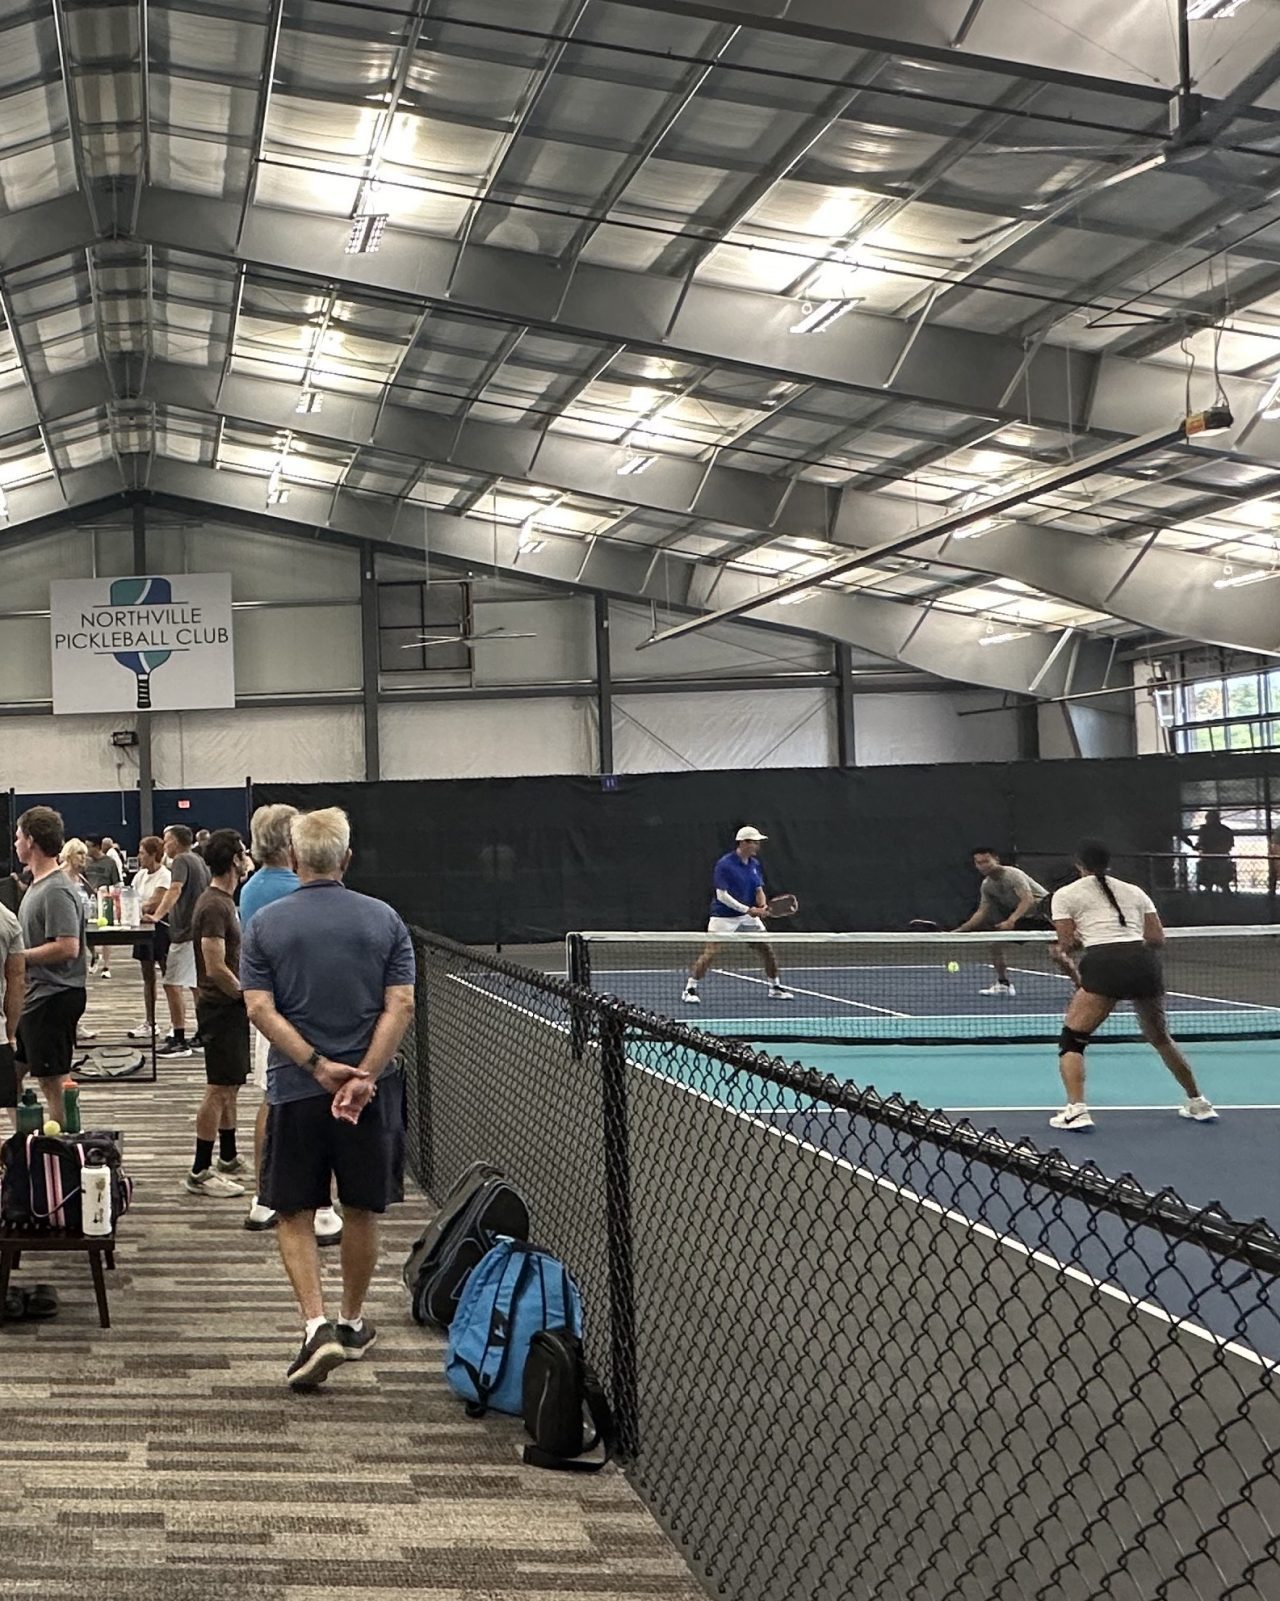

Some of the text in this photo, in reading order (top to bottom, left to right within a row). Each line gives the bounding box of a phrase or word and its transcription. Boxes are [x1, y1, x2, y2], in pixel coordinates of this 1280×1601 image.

[81, 608, 201, 628] NORTHVILLE
[55, 628, 229, 649] PICKLEBALL CLUB
